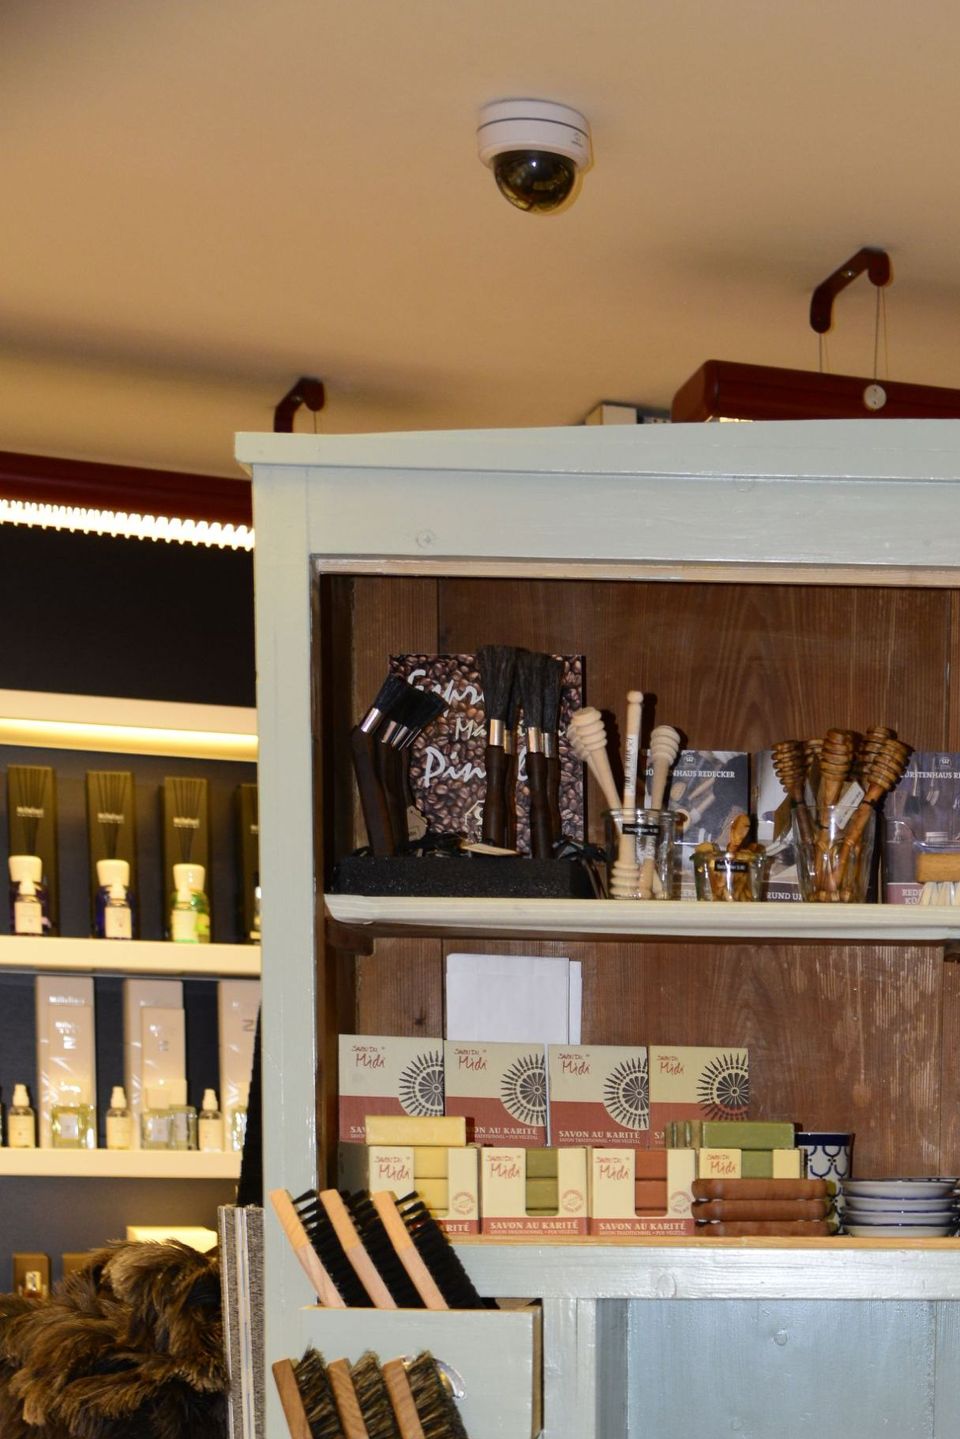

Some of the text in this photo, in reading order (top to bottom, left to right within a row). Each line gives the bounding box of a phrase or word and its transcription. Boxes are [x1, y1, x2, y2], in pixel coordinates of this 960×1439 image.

[698, 770, 735, 779] REDECKER
[503, 1126, 538, 1135] KARITÉ
[558, 1130, 590, 1138] SAVON
[606, 1129, 640, 1139] KARITÉ
[446, 1222, 469, 1232] RITÉ
[543, 1220, 579, 1229] KARITÉ
[651, 1220, 686, 1230] KARITÉ
